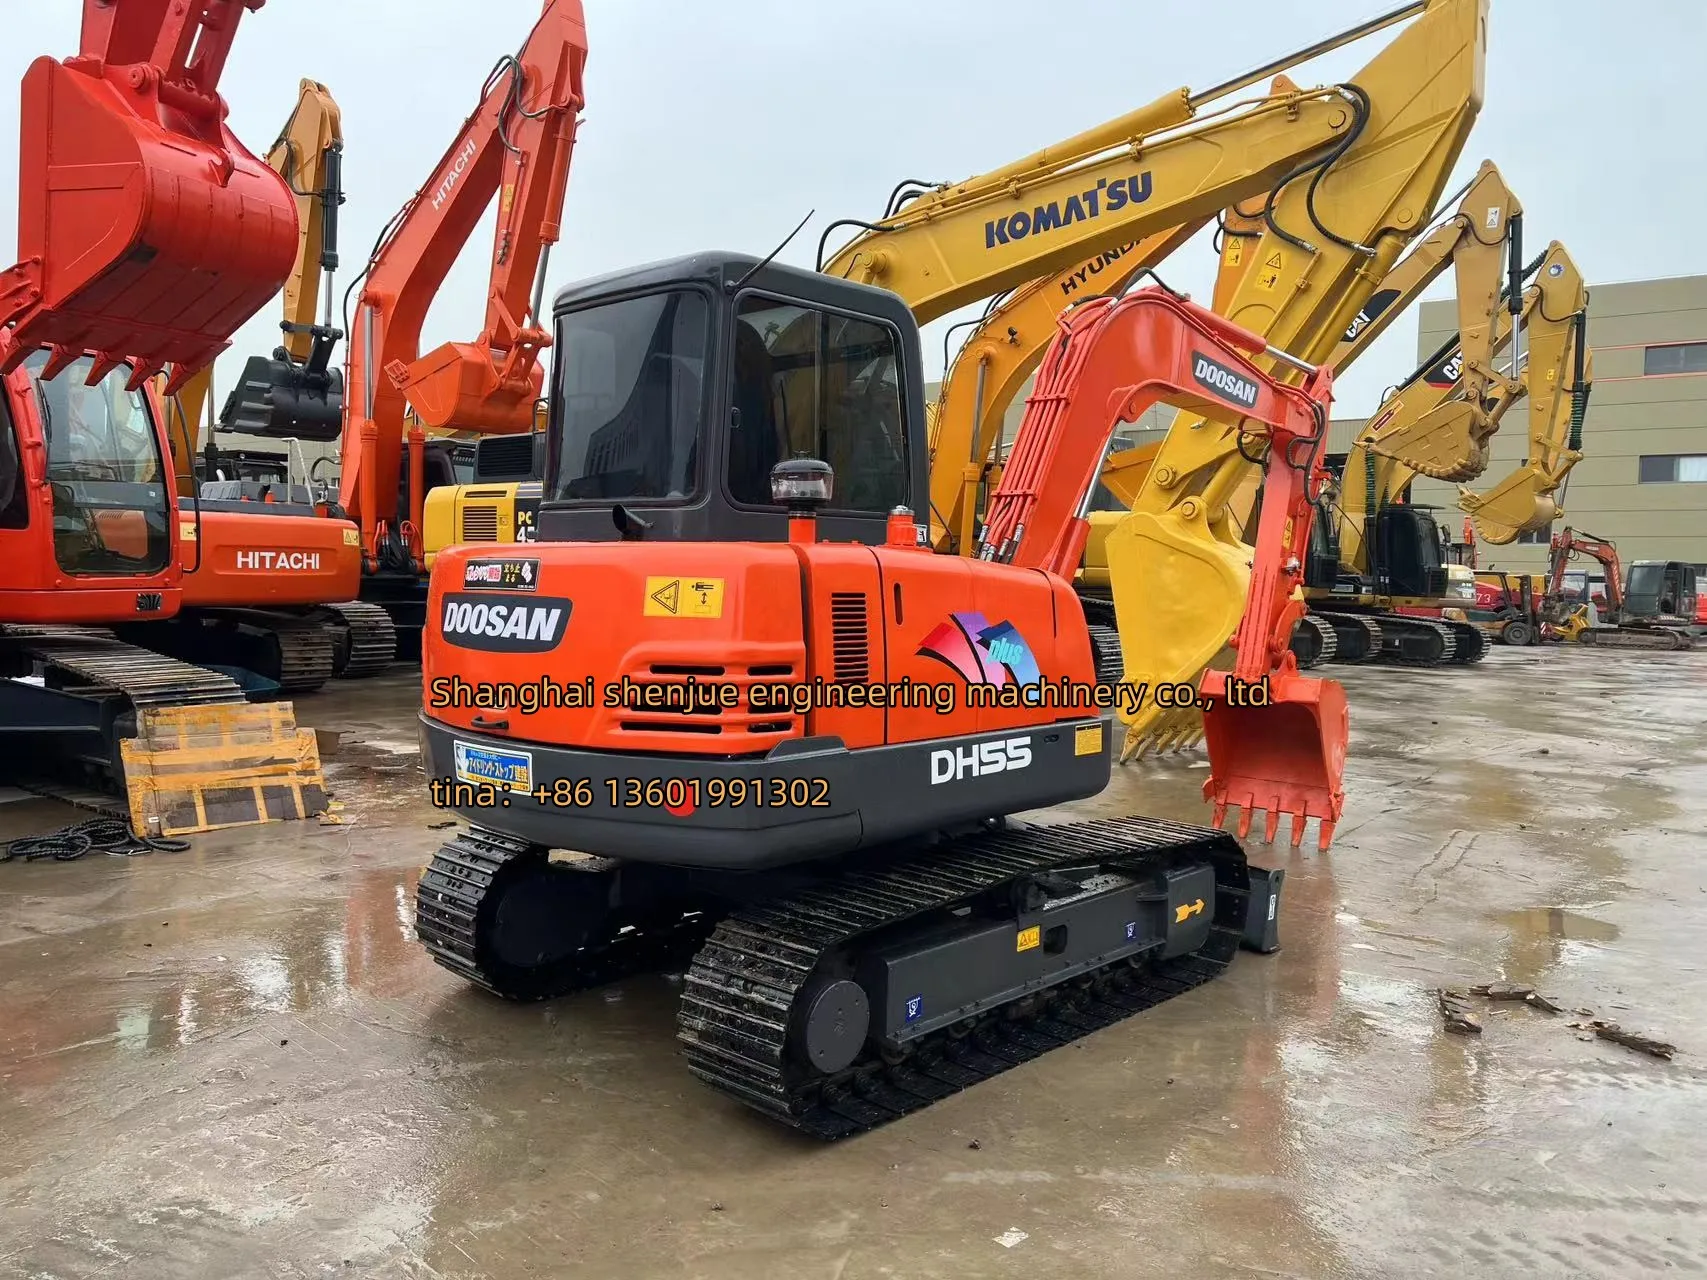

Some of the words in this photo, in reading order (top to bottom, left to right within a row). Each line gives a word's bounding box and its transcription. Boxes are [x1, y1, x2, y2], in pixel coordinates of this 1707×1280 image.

[432, 138, 476, 211] HITACHI
[985, 171, 1153, 249] KOMATSU
[1345, 308, 1371, 338] CAT
[1195, 358, 1256, 404] DOOSAN
[1442, 351, 1463, 380] CA
[517, 510, 533, 525] PC
[236, 551, 319, 569] HITACHI
[443, 602, 561, 641] DOOSAN
[986, 637, 1023, 665] plus
[930, 735, 1033, 786] DH55
